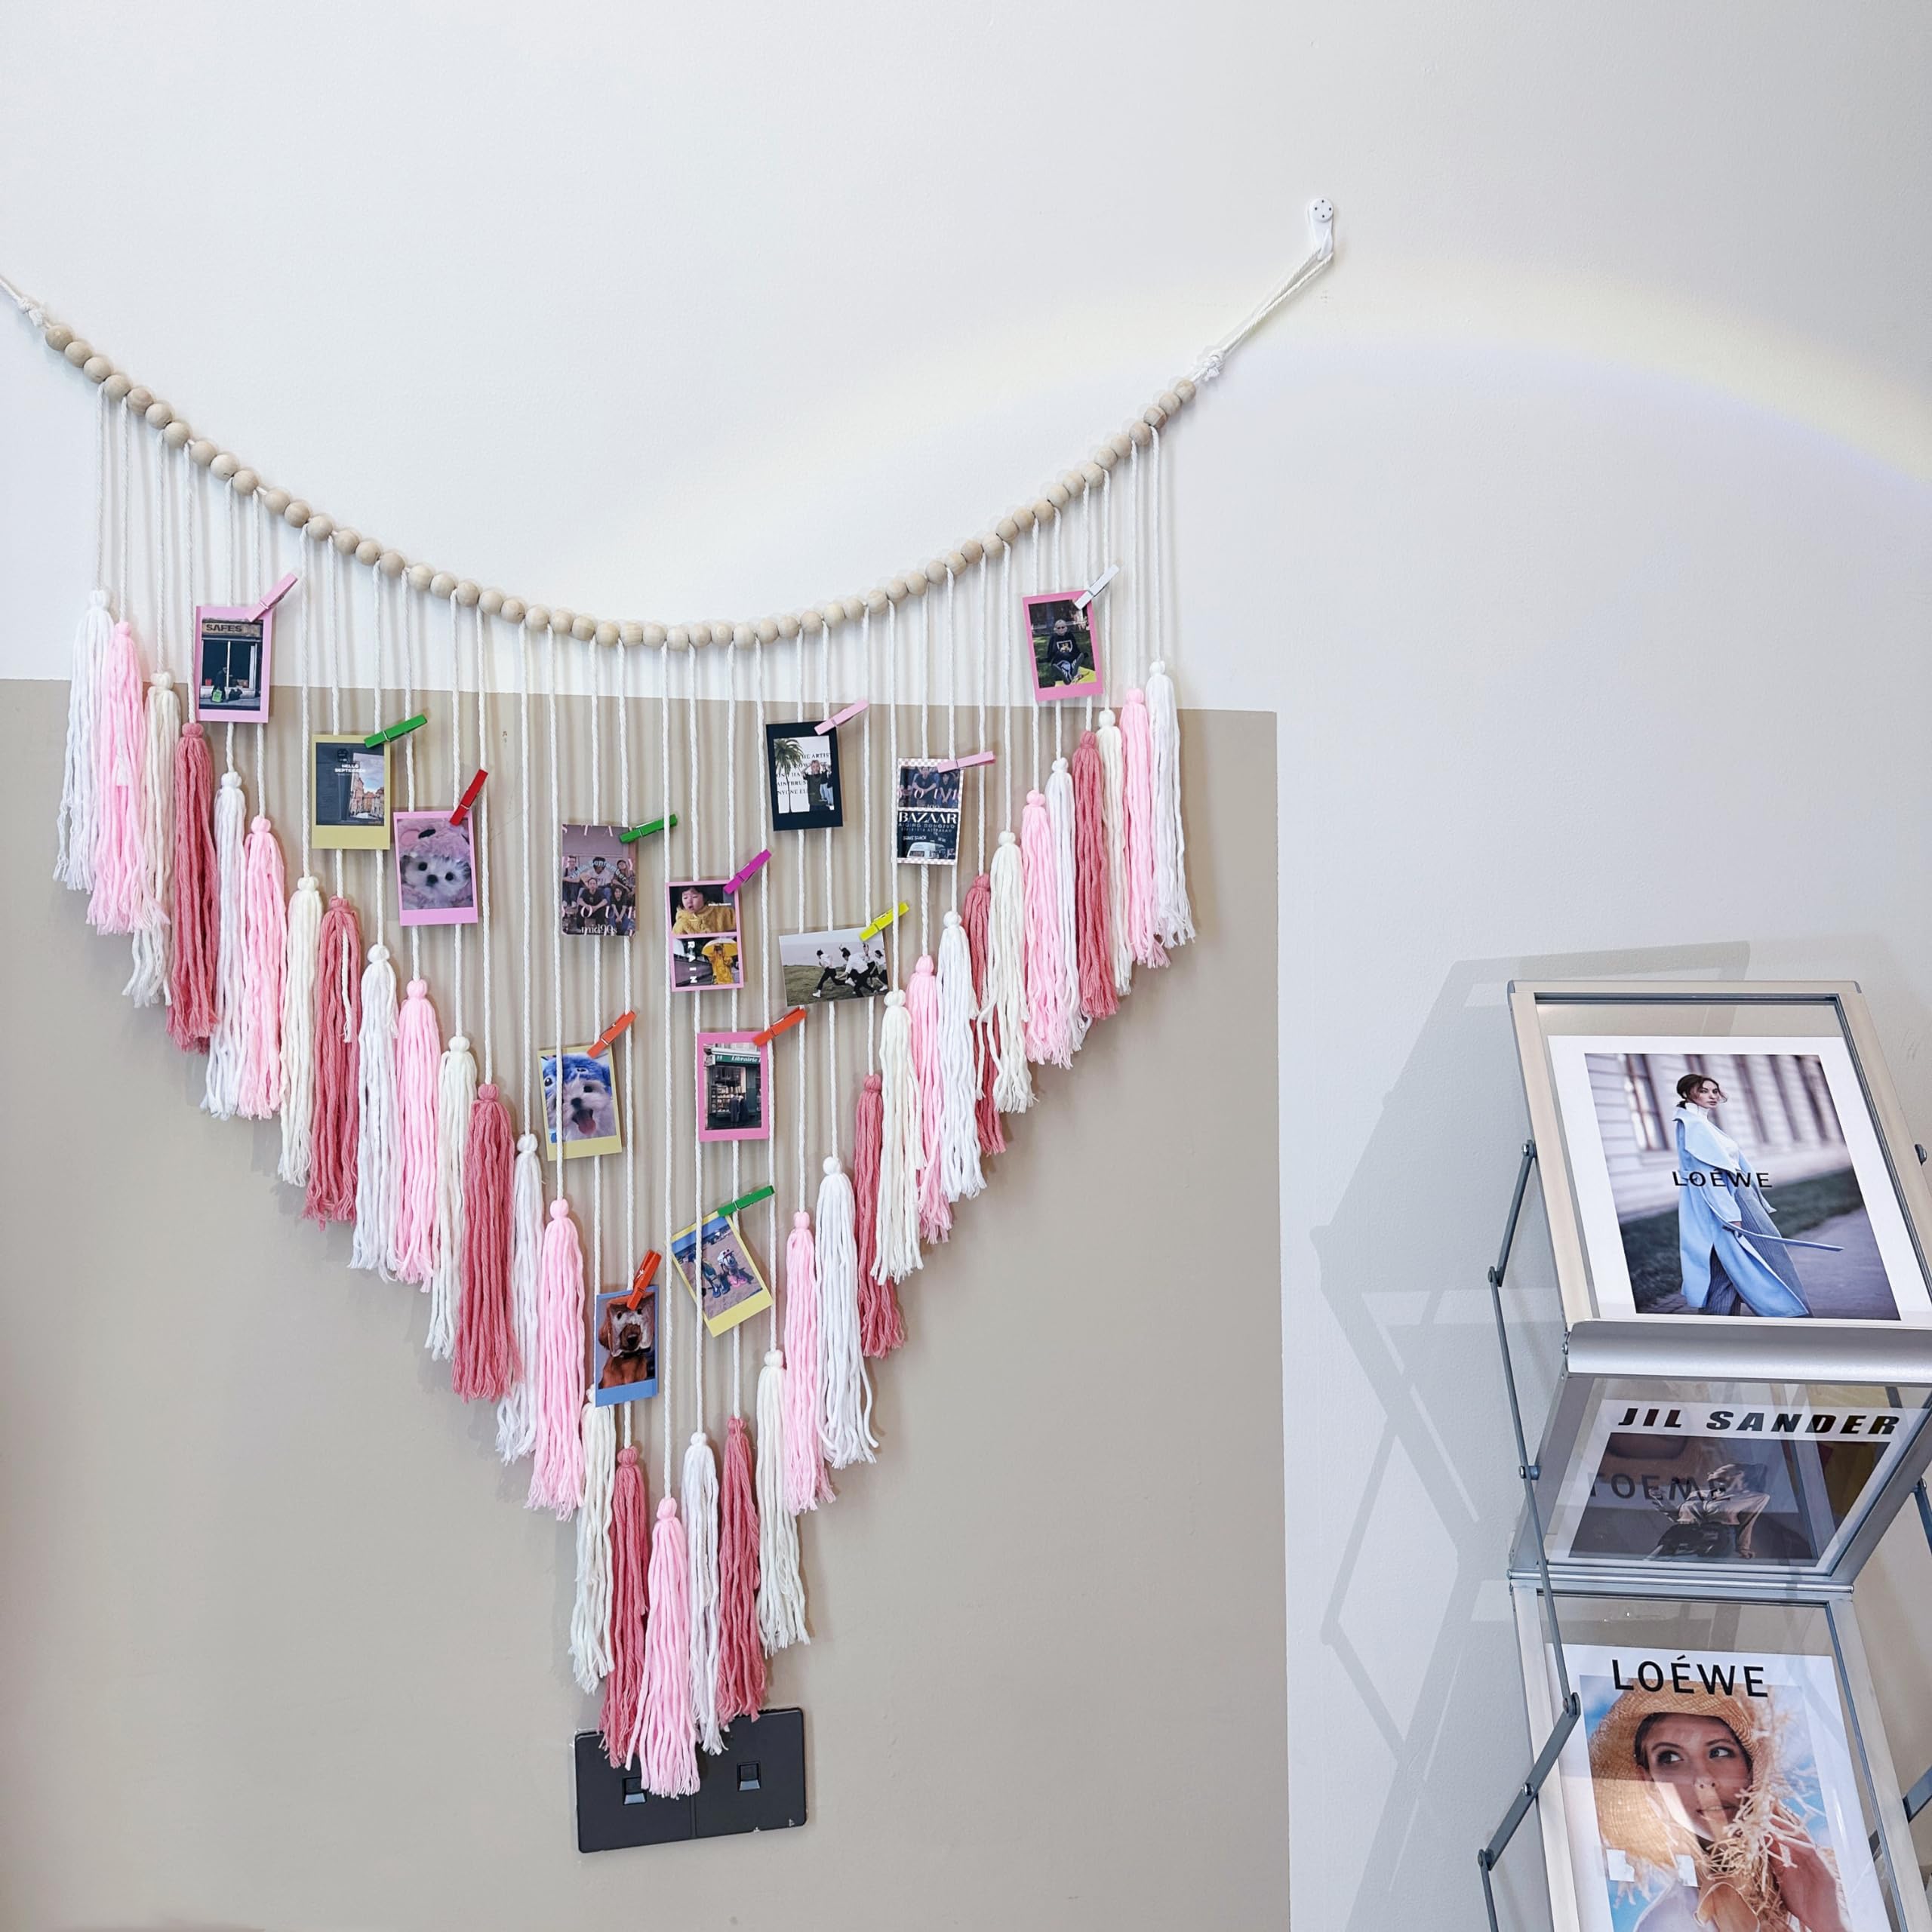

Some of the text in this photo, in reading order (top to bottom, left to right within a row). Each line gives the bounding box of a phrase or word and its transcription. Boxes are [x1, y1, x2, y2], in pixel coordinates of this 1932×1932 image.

[206, 623, 242, 632] SAFES
[899, 811, 957, 824] BAZAAR
[1618, 1407, 1900, 1435] JIL SANDER
[1612, 1654, 1768, 1697] LOÉWE
